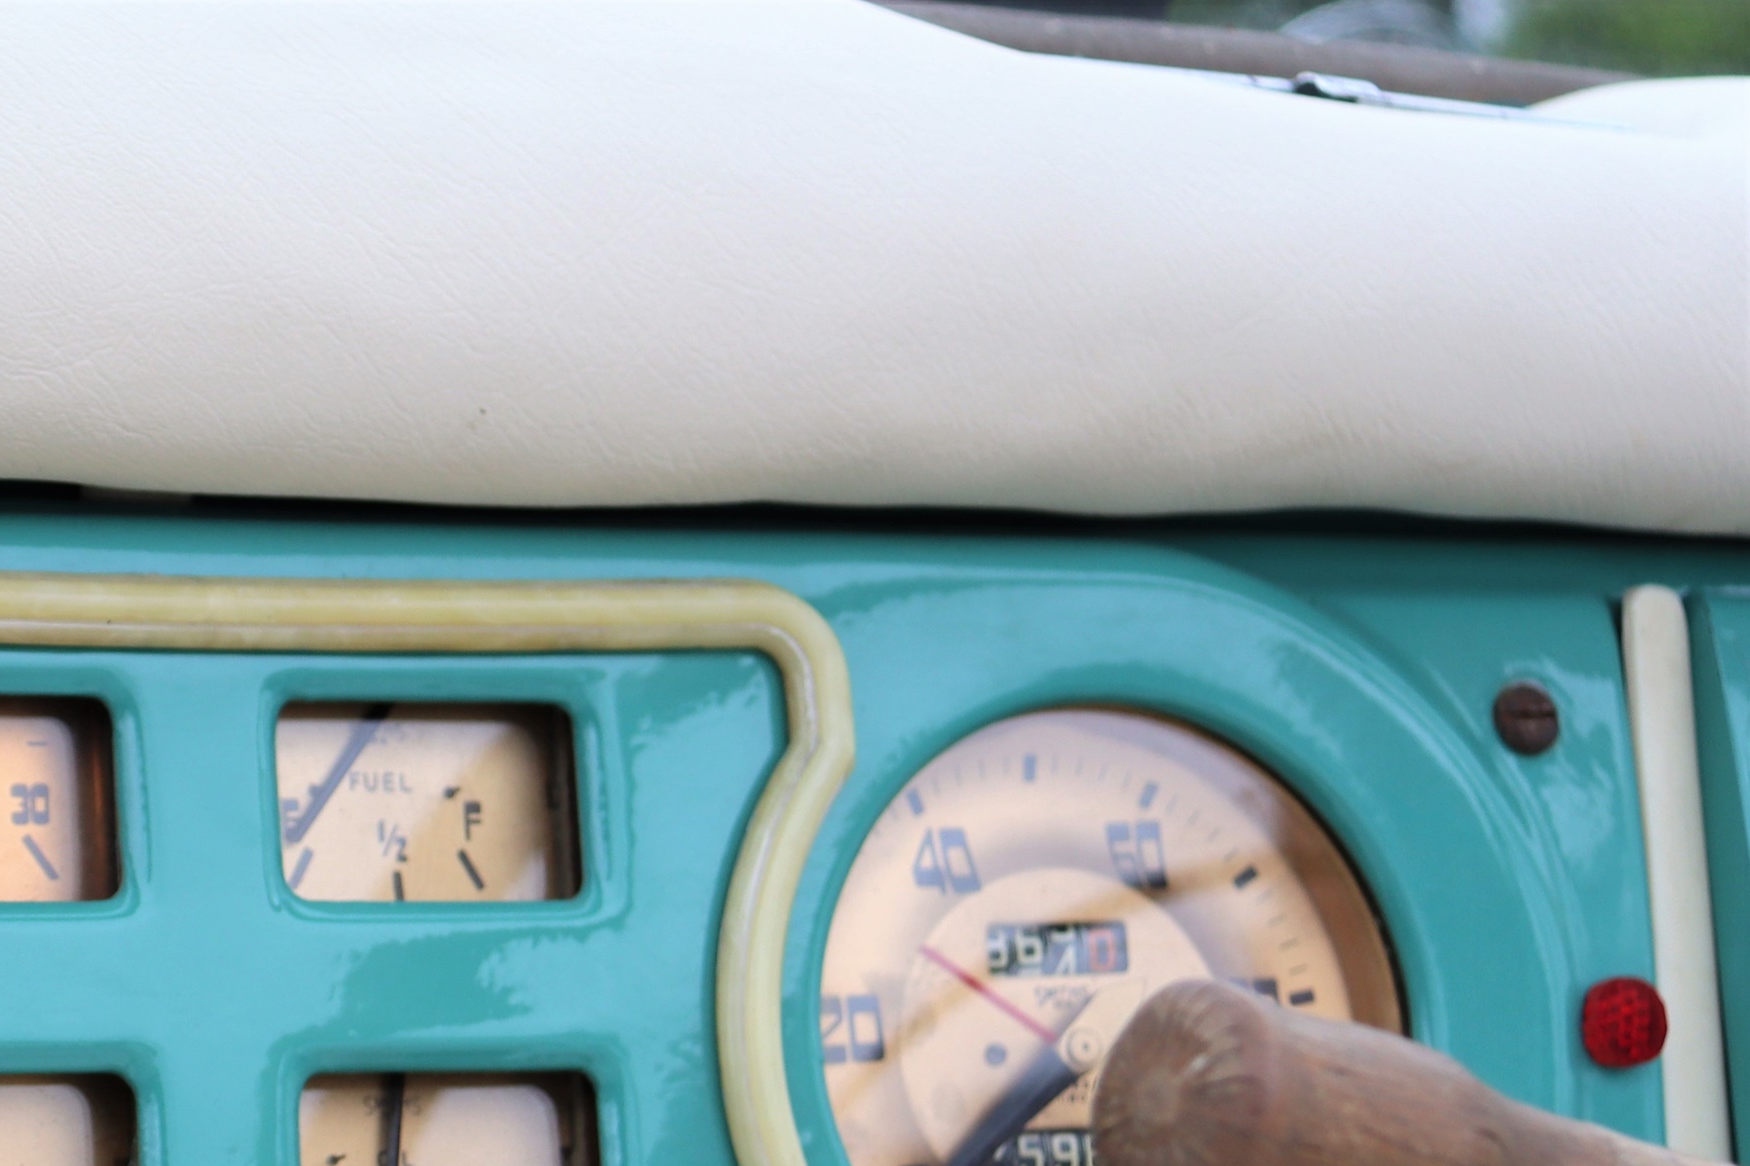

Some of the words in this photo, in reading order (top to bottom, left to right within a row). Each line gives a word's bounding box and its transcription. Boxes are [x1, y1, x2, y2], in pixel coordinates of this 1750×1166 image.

[10, 783, 51, 826] 30
[350, 771, 412, 793] FUEL
[463, 801, 482, 841] F
[913, 828, 981, 894] 40
[1106, 820, 1167, 890] 60
[821, 995, 884, 1064] 20
